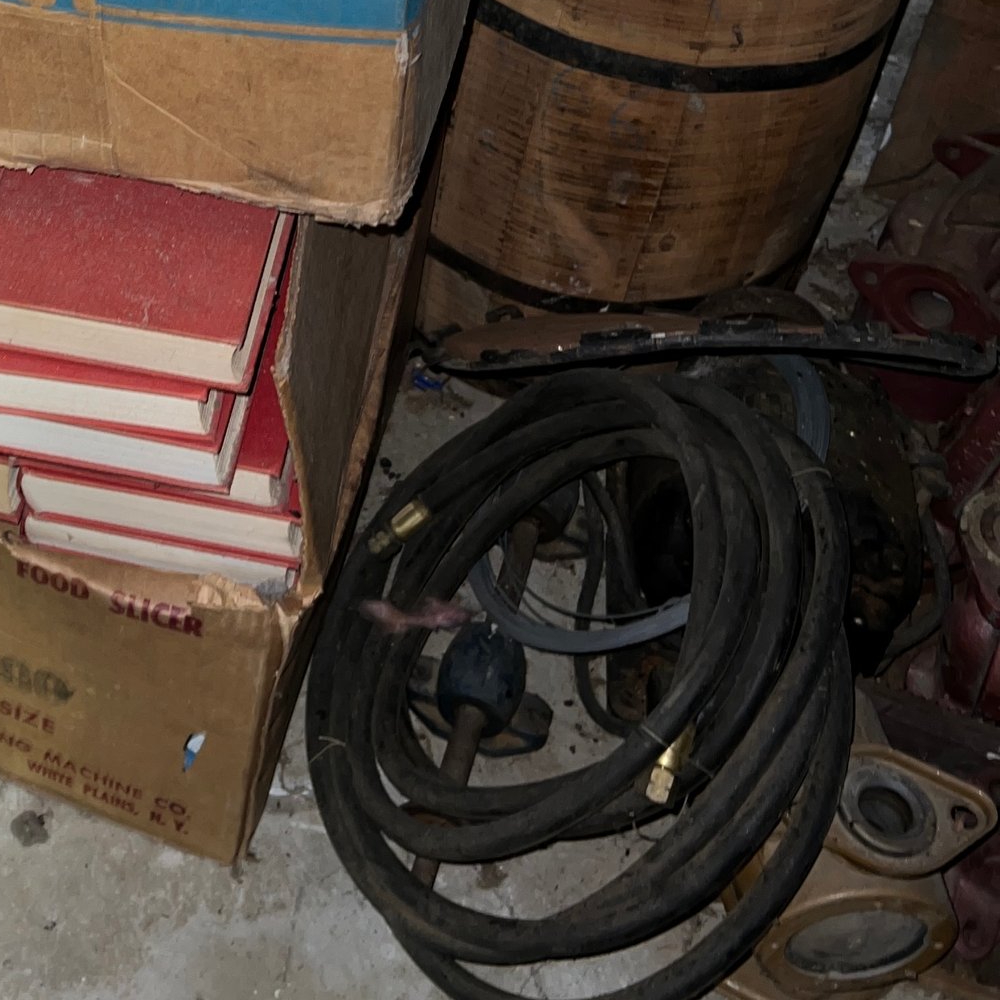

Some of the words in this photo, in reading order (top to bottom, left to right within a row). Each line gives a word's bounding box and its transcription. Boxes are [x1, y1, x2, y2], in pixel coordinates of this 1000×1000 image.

[16, 559, 90, 600] FOOD
[108, 589, 204, 637] SLICER
[27, 759, 74, 788] WHITE
[43, 750, 143, 800] MACHINE
